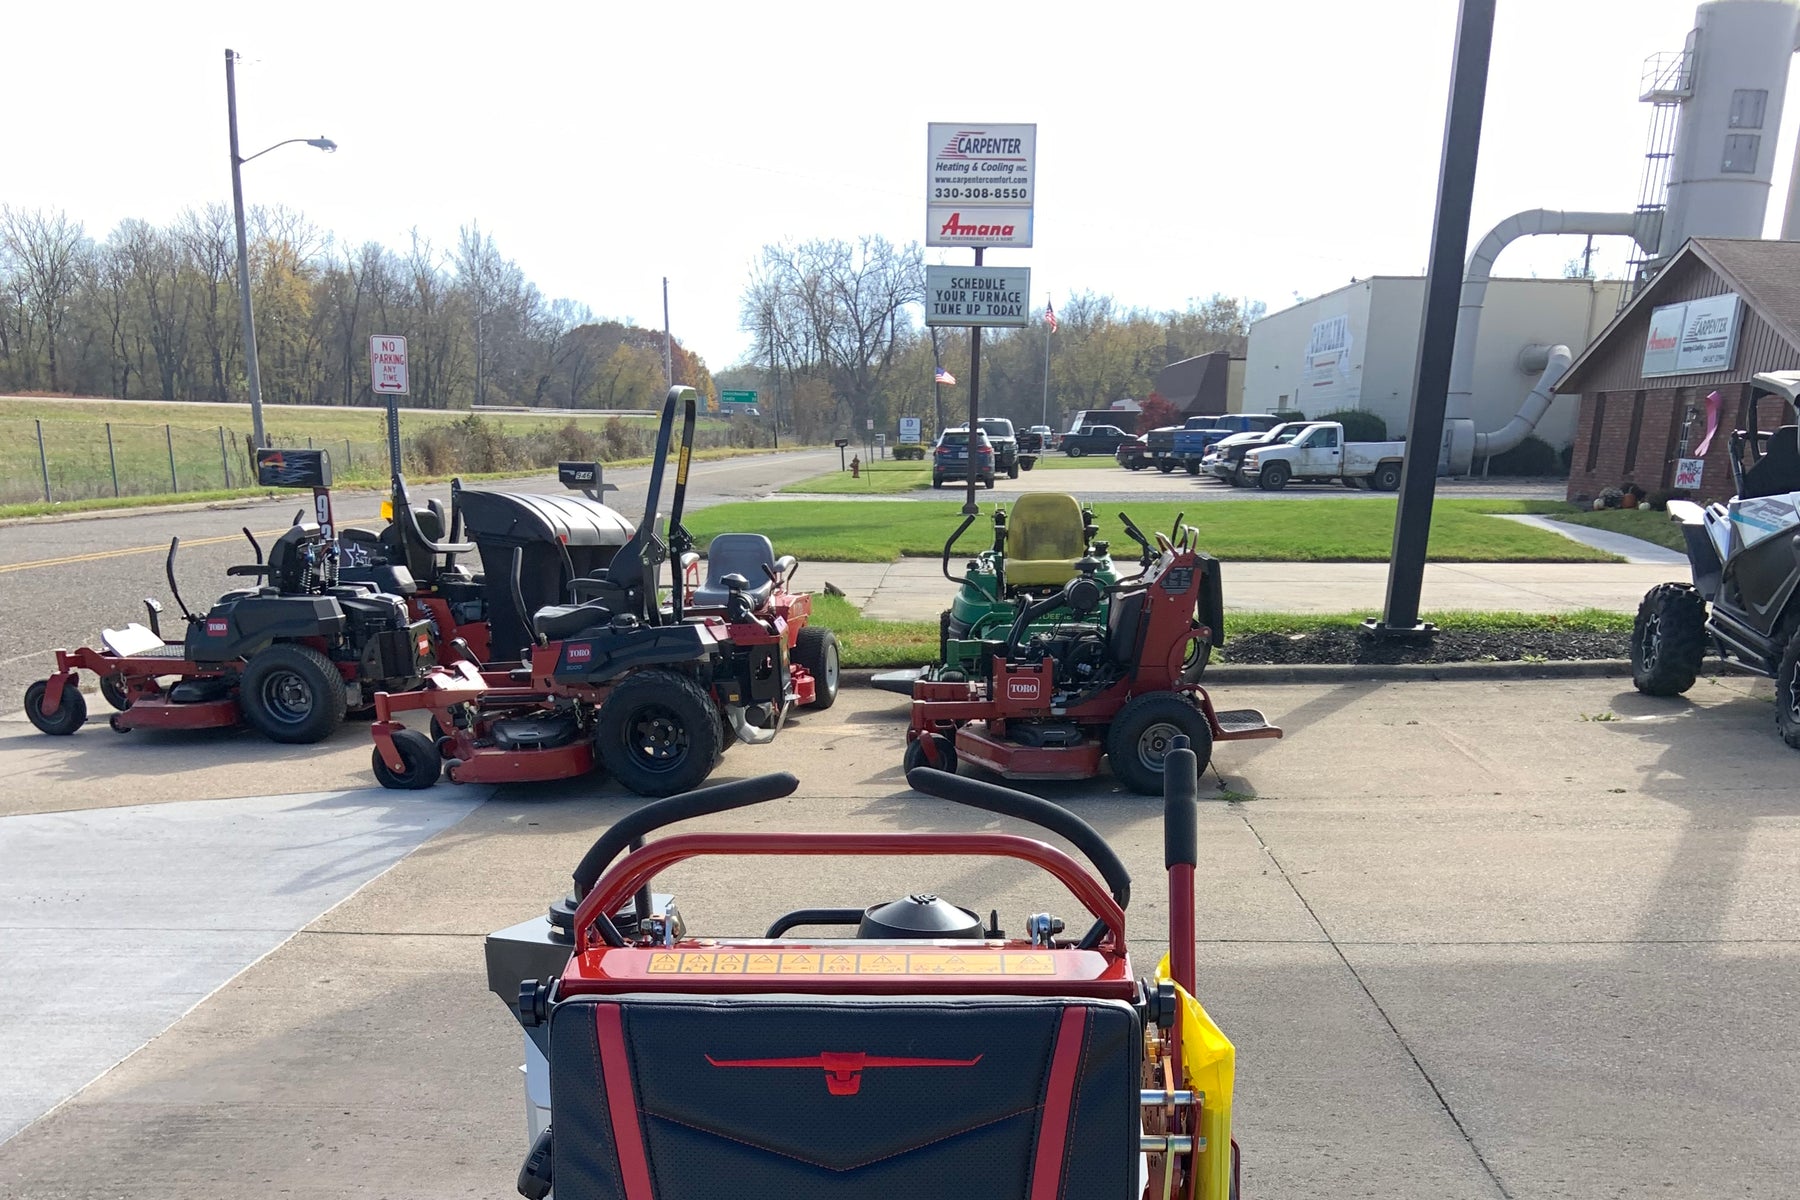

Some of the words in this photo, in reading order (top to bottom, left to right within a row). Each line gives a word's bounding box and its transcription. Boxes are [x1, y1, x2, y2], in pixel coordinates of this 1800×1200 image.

[957, 138, 1021, 154] CARPENTER
[935, 162, 970, 174] Heating
[972, 162, 978, 171] &
[981, 162, 1014, 174] Cooling
[935, 176, 1028, 185] www.carpentercomfort.com
[935, 188, 1027, 198] 330-308-8550
[941, 212, 1015, 235] Amana
[951, 278, 1006, 290] SCHEDULE
[936, 290, 966, 302] YOUR
[972, 291, 1021, 303] FURNACE
[934, 303, 961, 315] TUNE
[966, 304, 981, 315] UP
[987, 304, 1022, 316] TODAY
[381, 341, 395, 352] NO
[374, 353, 405, 366] PARKING
[383, 365, 397, 373] ANY
[382, 374, 398, 382] TIME
[568, 648, 590, 658] TORO
[1010, 683, 1037, 693] TORO
